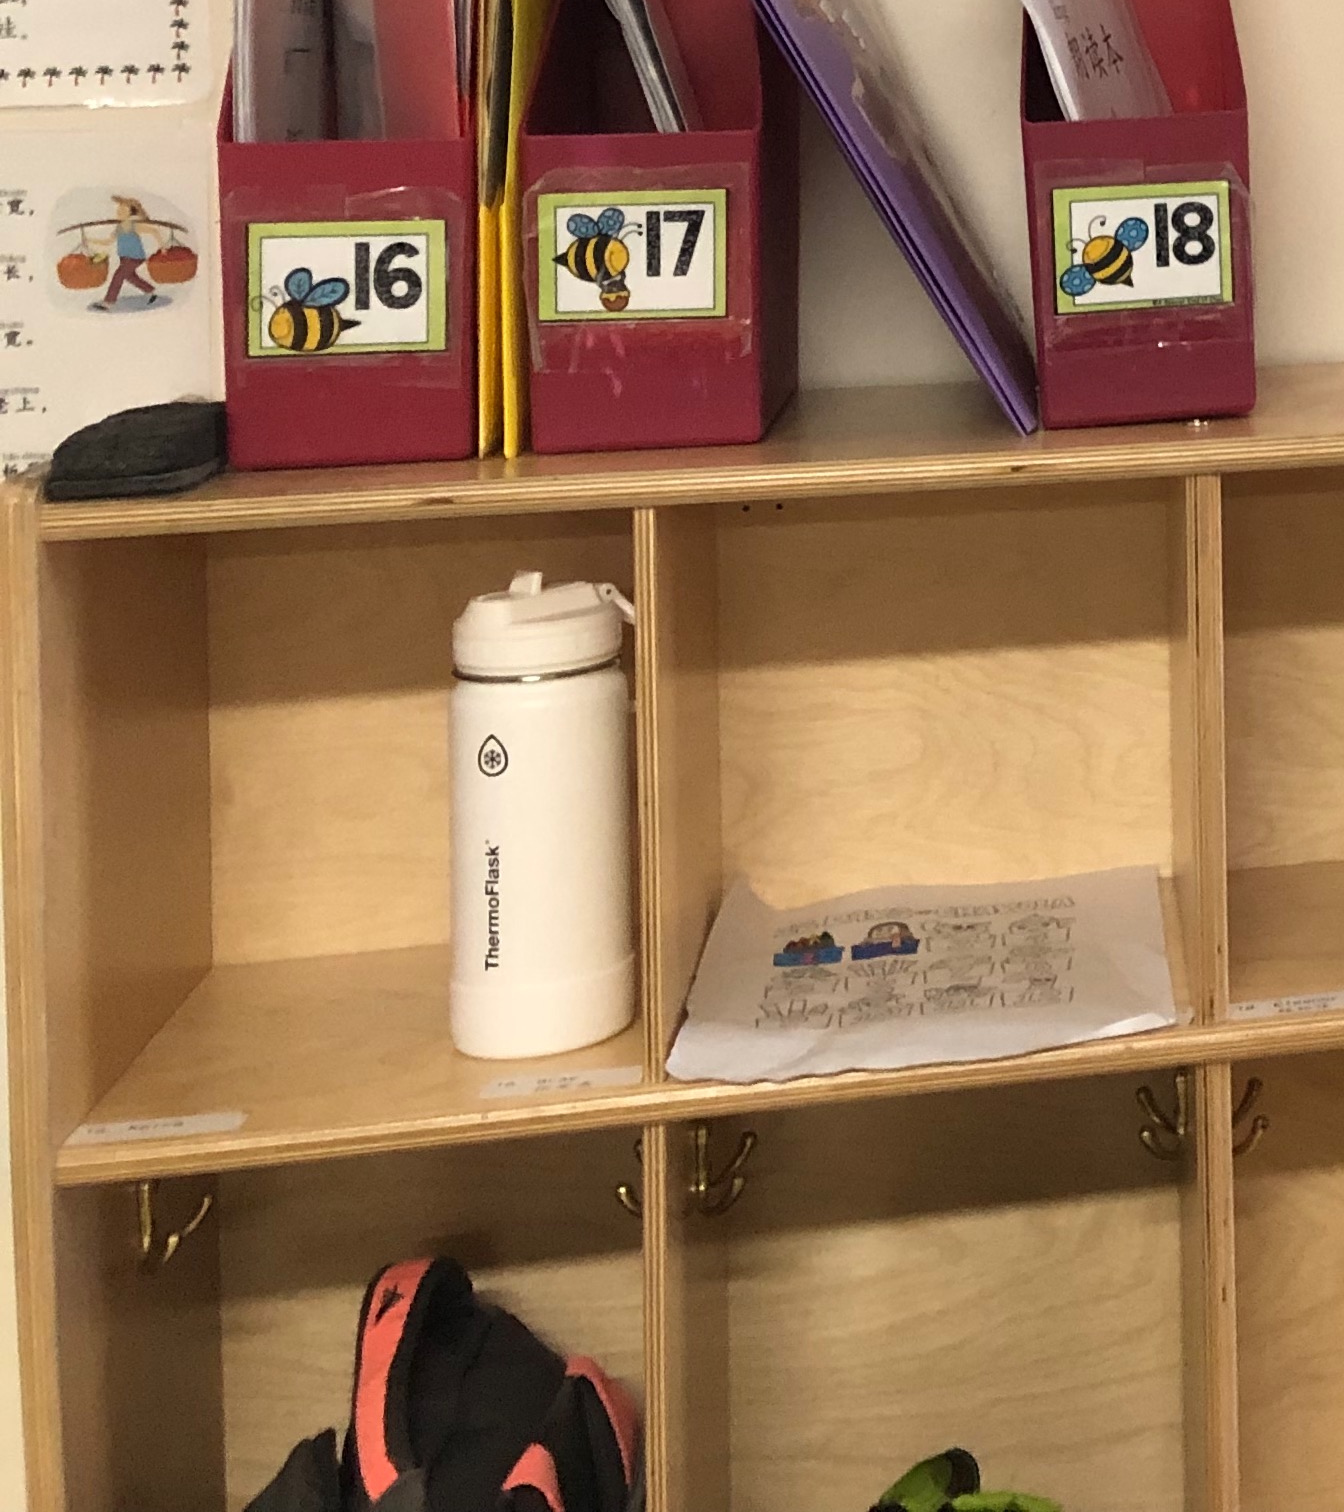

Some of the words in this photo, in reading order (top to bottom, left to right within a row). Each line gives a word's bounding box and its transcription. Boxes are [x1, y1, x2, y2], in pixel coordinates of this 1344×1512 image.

[645, 209, 706, 278] 17
[1154, 202, 1216, 268] 18
[353, 241, 423, 311] 16
[485, 846, 500, 971] ThermoFlask
